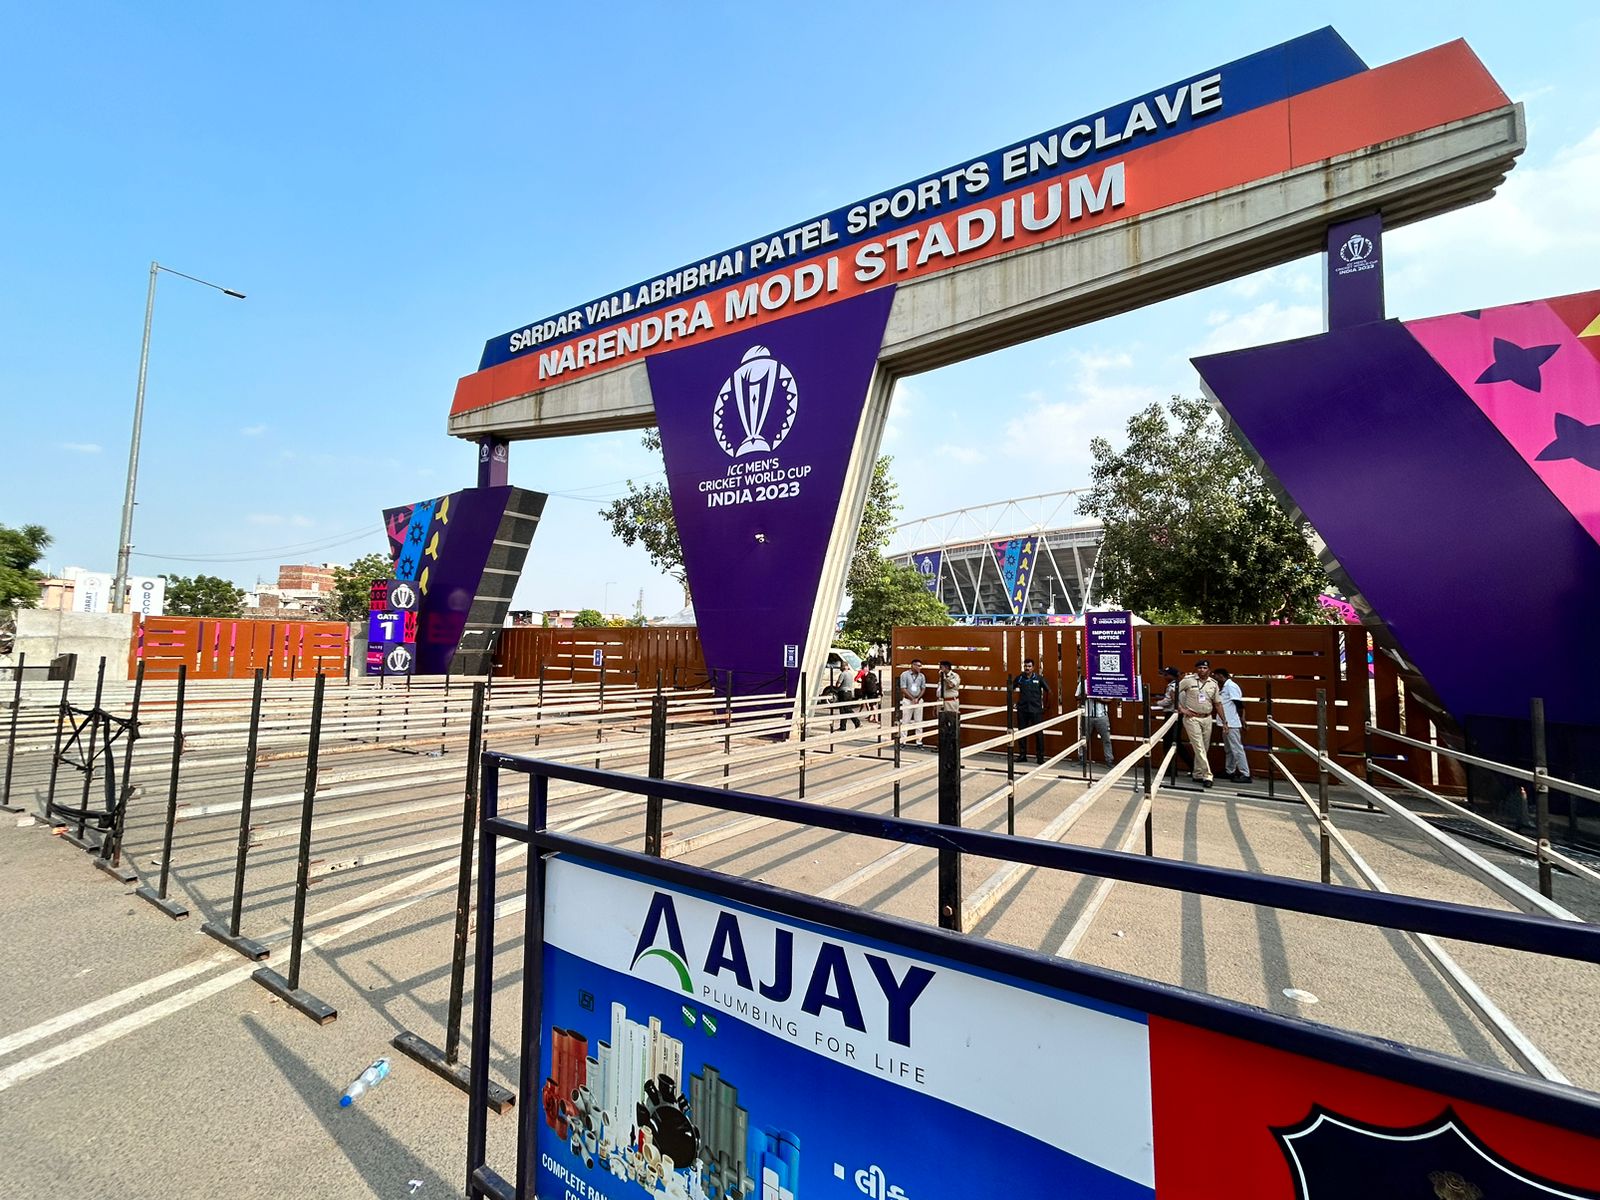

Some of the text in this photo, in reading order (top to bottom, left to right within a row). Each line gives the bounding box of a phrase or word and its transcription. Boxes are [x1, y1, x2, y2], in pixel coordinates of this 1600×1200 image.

[509, 72, 1223, 353] SARDAR VALLABHBHAI PATEL SPORTS ENCLAVE
[538, 160, 1126, 381] NARENDRA MODI STADIUM
[698, 465, 812, 492] CRICKET WORLD CUP
[727, 457, 780, 477] ICC MEN'S
[707, 481, 801, 508] INDIA 2023
[377, 613, 399, 621] GATE
[380, 621, 394, 641] 1
[703, 985, 798, 1037] PLUMBING
[815, 1031, 856, 1060] FOR
[875, 1053, 925, 1085] LIFE
[542, 1153, 586, 1196] COMPLETE
